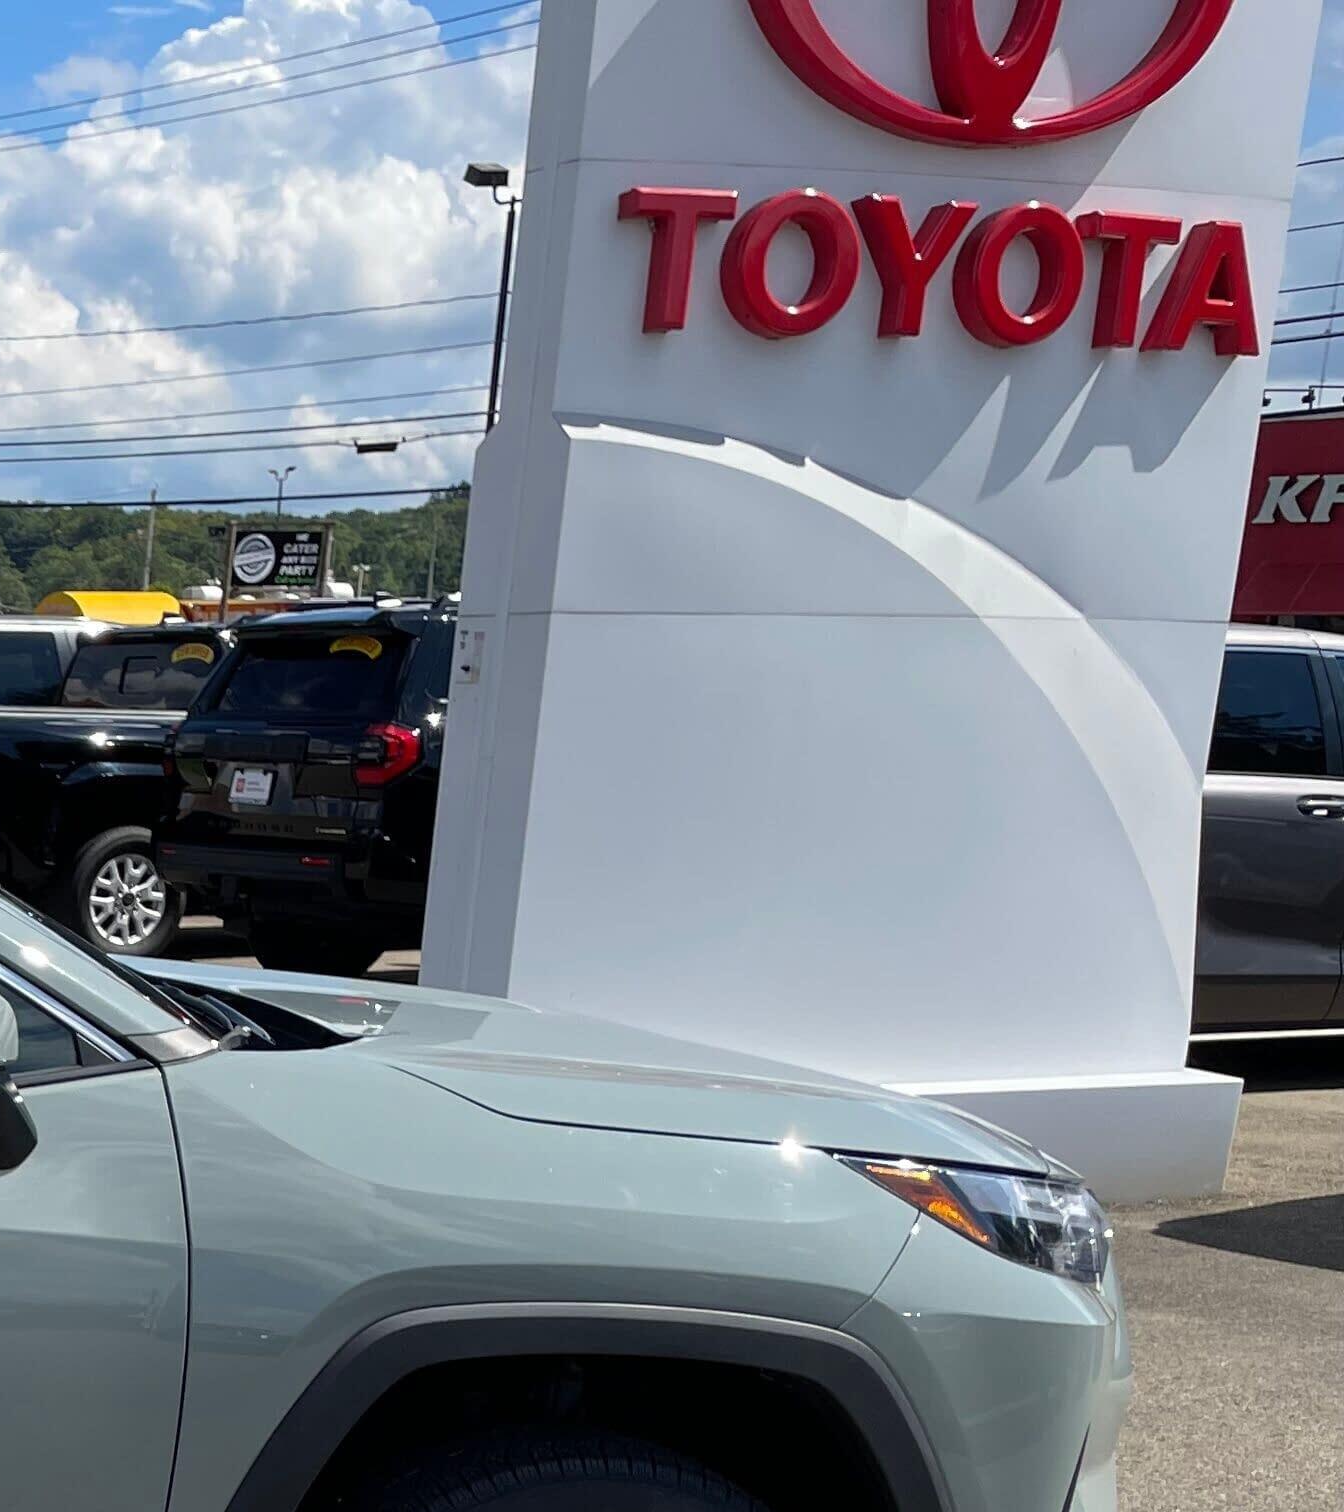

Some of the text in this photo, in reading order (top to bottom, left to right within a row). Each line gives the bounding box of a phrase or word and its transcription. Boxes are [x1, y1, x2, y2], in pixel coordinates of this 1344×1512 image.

[617, 186, 1260, 357] TOYOTA
[283, 543, 319, 554] CATER
[279, 565, 315, 576] PARTY
